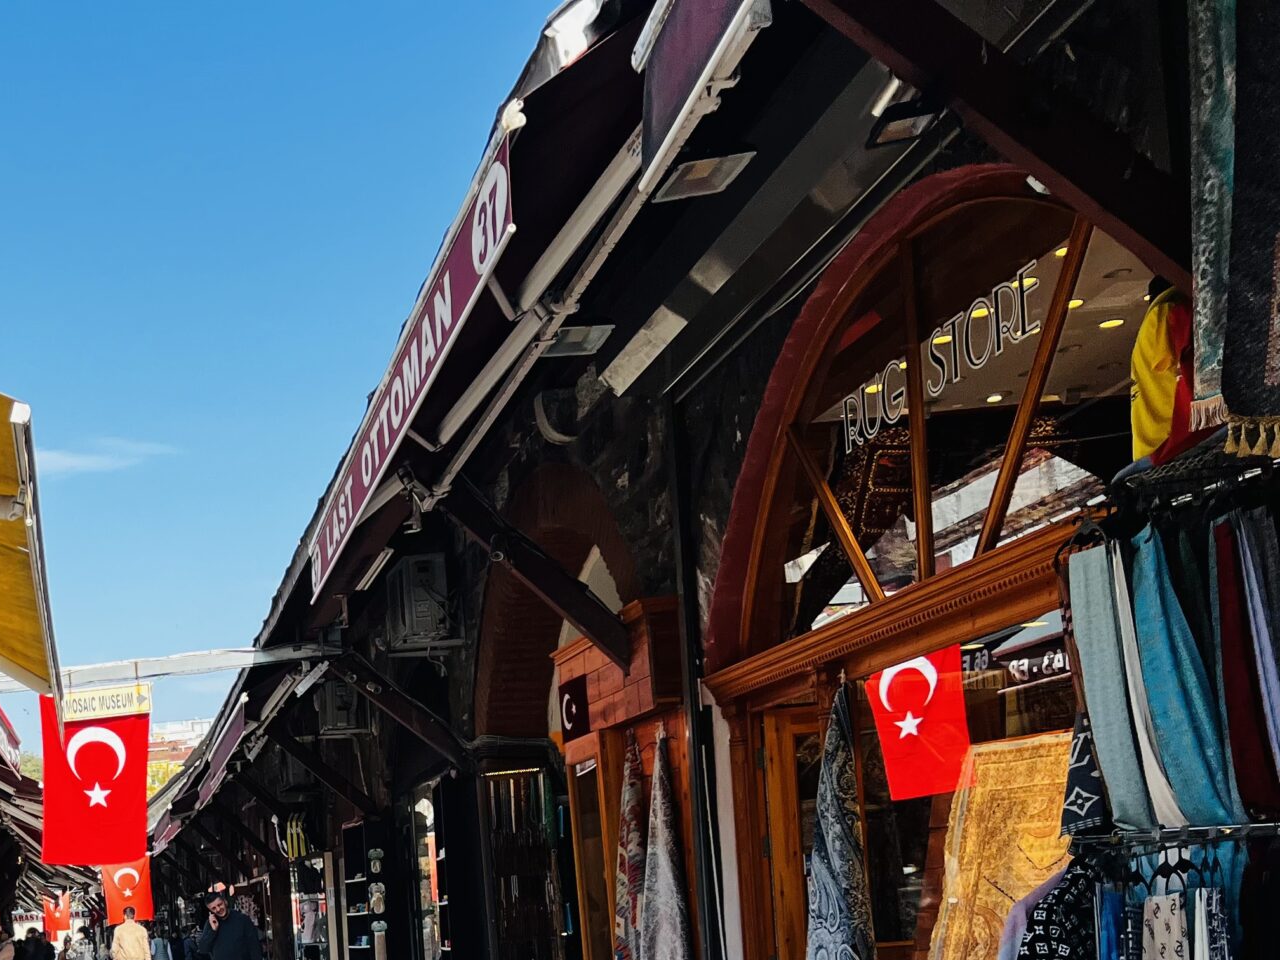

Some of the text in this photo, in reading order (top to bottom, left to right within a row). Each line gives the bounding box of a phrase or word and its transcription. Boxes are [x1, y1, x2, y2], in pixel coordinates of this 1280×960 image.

[326, 475, 354, 556] LAST
[360, 268, 453, 488] OTTOMAN
[476, 172, 506, 267] 37
[843, 259, 1041, 454] RUG STORE
[65, 693, 134, 715] MOSAIC MUSEUM
[14, 913, 40, 922] ARAST
